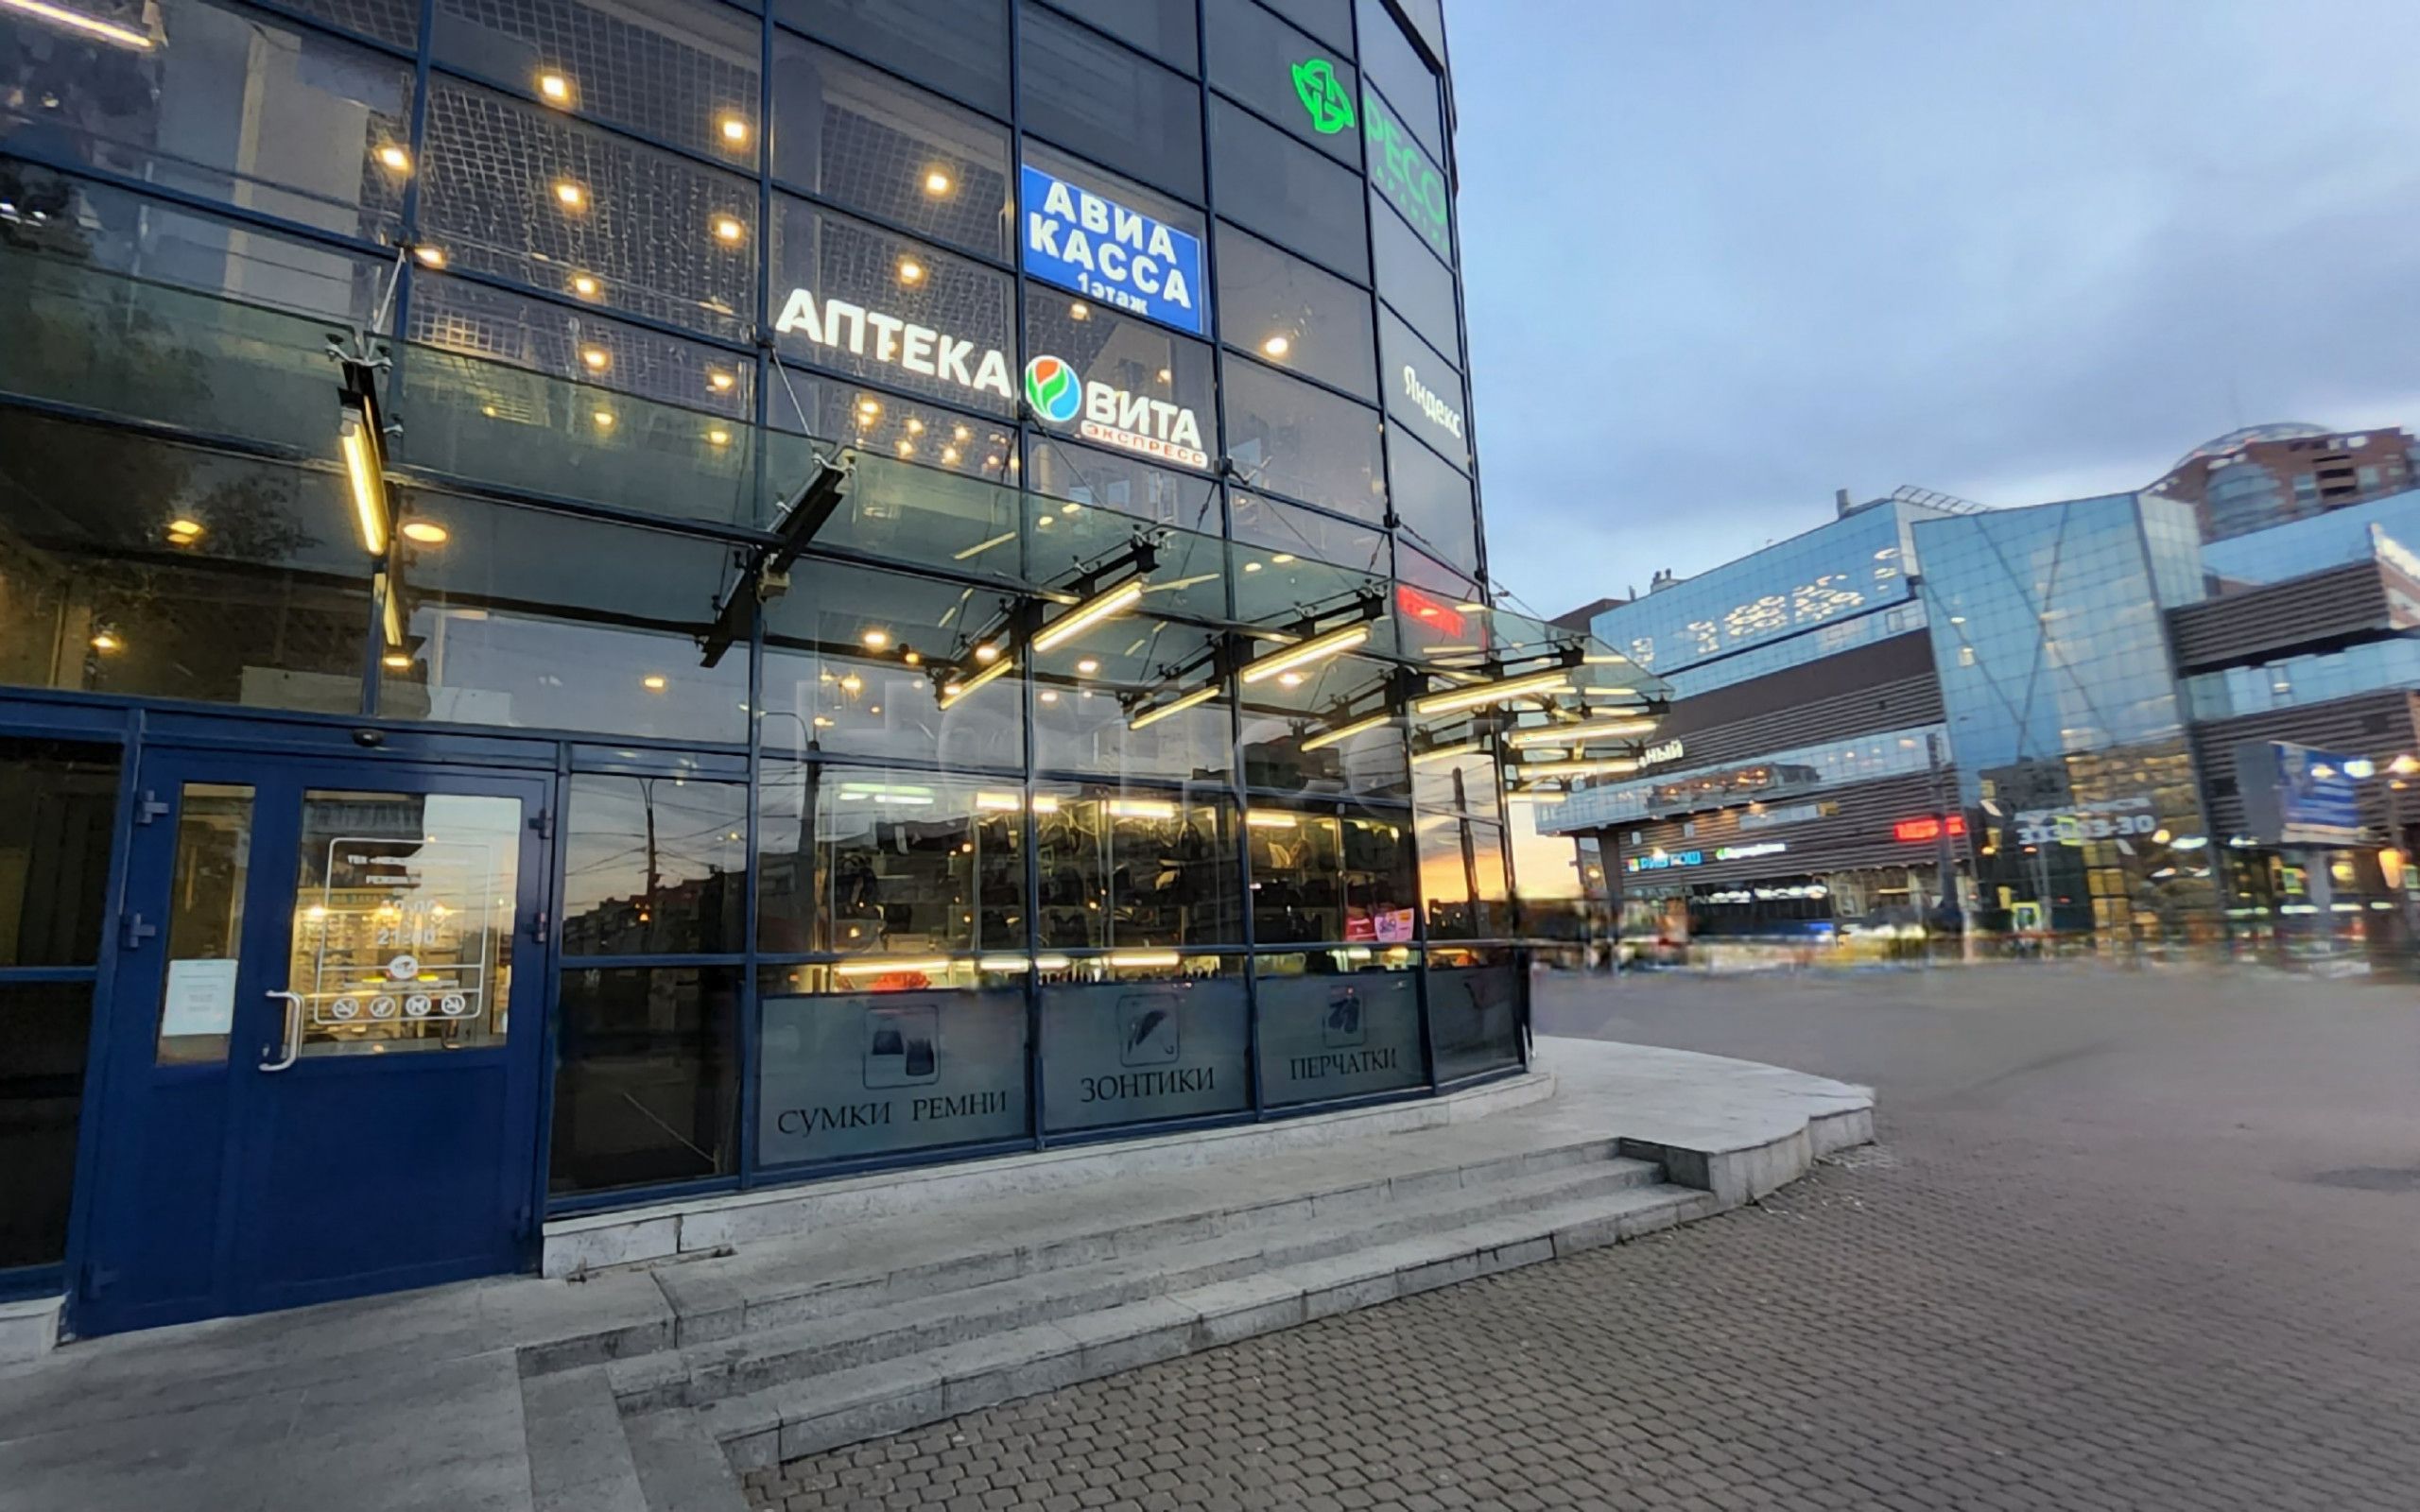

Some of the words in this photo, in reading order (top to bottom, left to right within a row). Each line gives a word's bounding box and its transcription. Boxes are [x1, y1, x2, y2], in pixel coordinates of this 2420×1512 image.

[1044, 181, 1177, 265] АВИА
[1029, 212, 1192, 310] КАССА
[775, 287, 1011, 398] АПТЕКА
[1085, 380, 1202, 449] ВИТА
[1403, 364, 1461, 438] Яндекс
[1084, 423, 1203, 464] ЭКСПРЕСС
[1080, 1067, 1214, 1103] ЗОНТИКИ
[1290, 1048, 1397, 1080] ПЕРЧАТКИ
[777, 1102, 891, 1137] СУМКИ
[912, 1091, 1008, 1122] РЕМНИ
